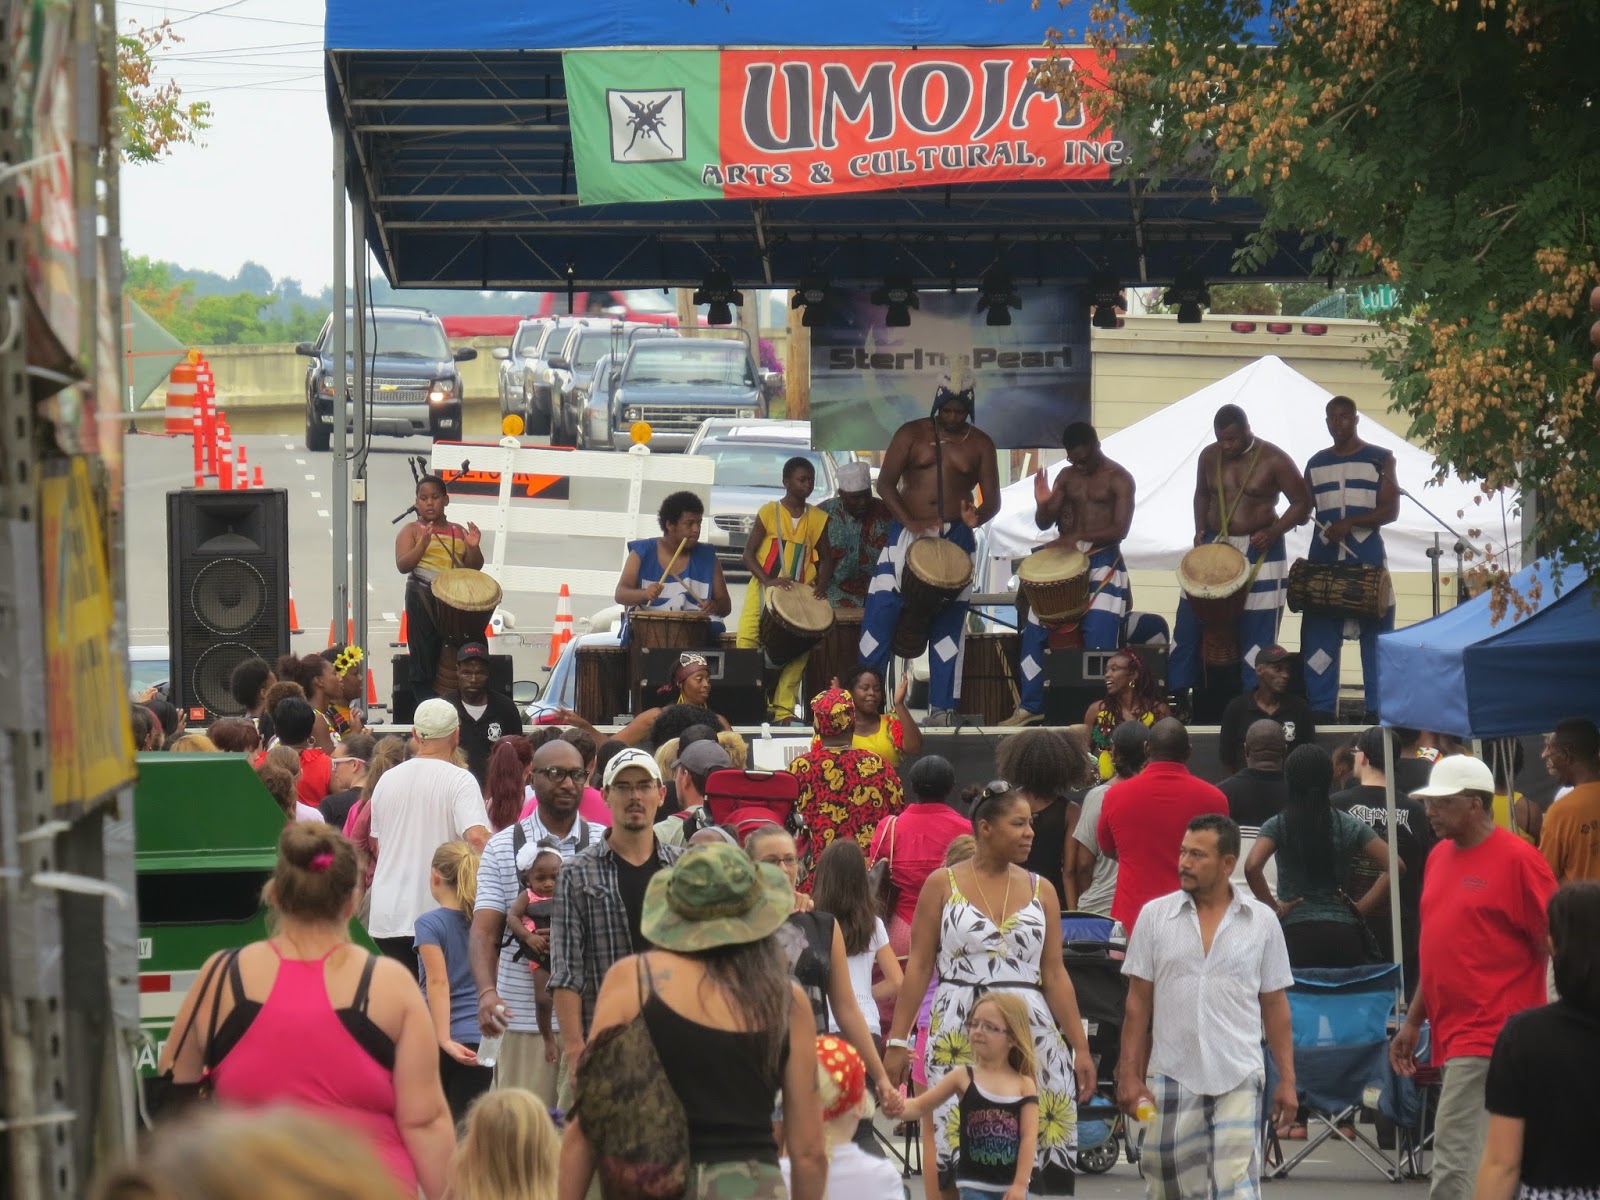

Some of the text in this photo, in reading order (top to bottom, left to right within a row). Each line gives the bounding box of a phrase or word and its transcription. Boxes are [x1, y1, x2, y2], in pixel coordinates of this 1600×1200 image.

[741, 58, 1086, 153] UMOJA
[701, 163, 793, 186] ARTS
[808, 161, 835, 185] &
[848, 140, 1046, 177] CULTURAL,
[973, 347, 1072, 369] Pearl
